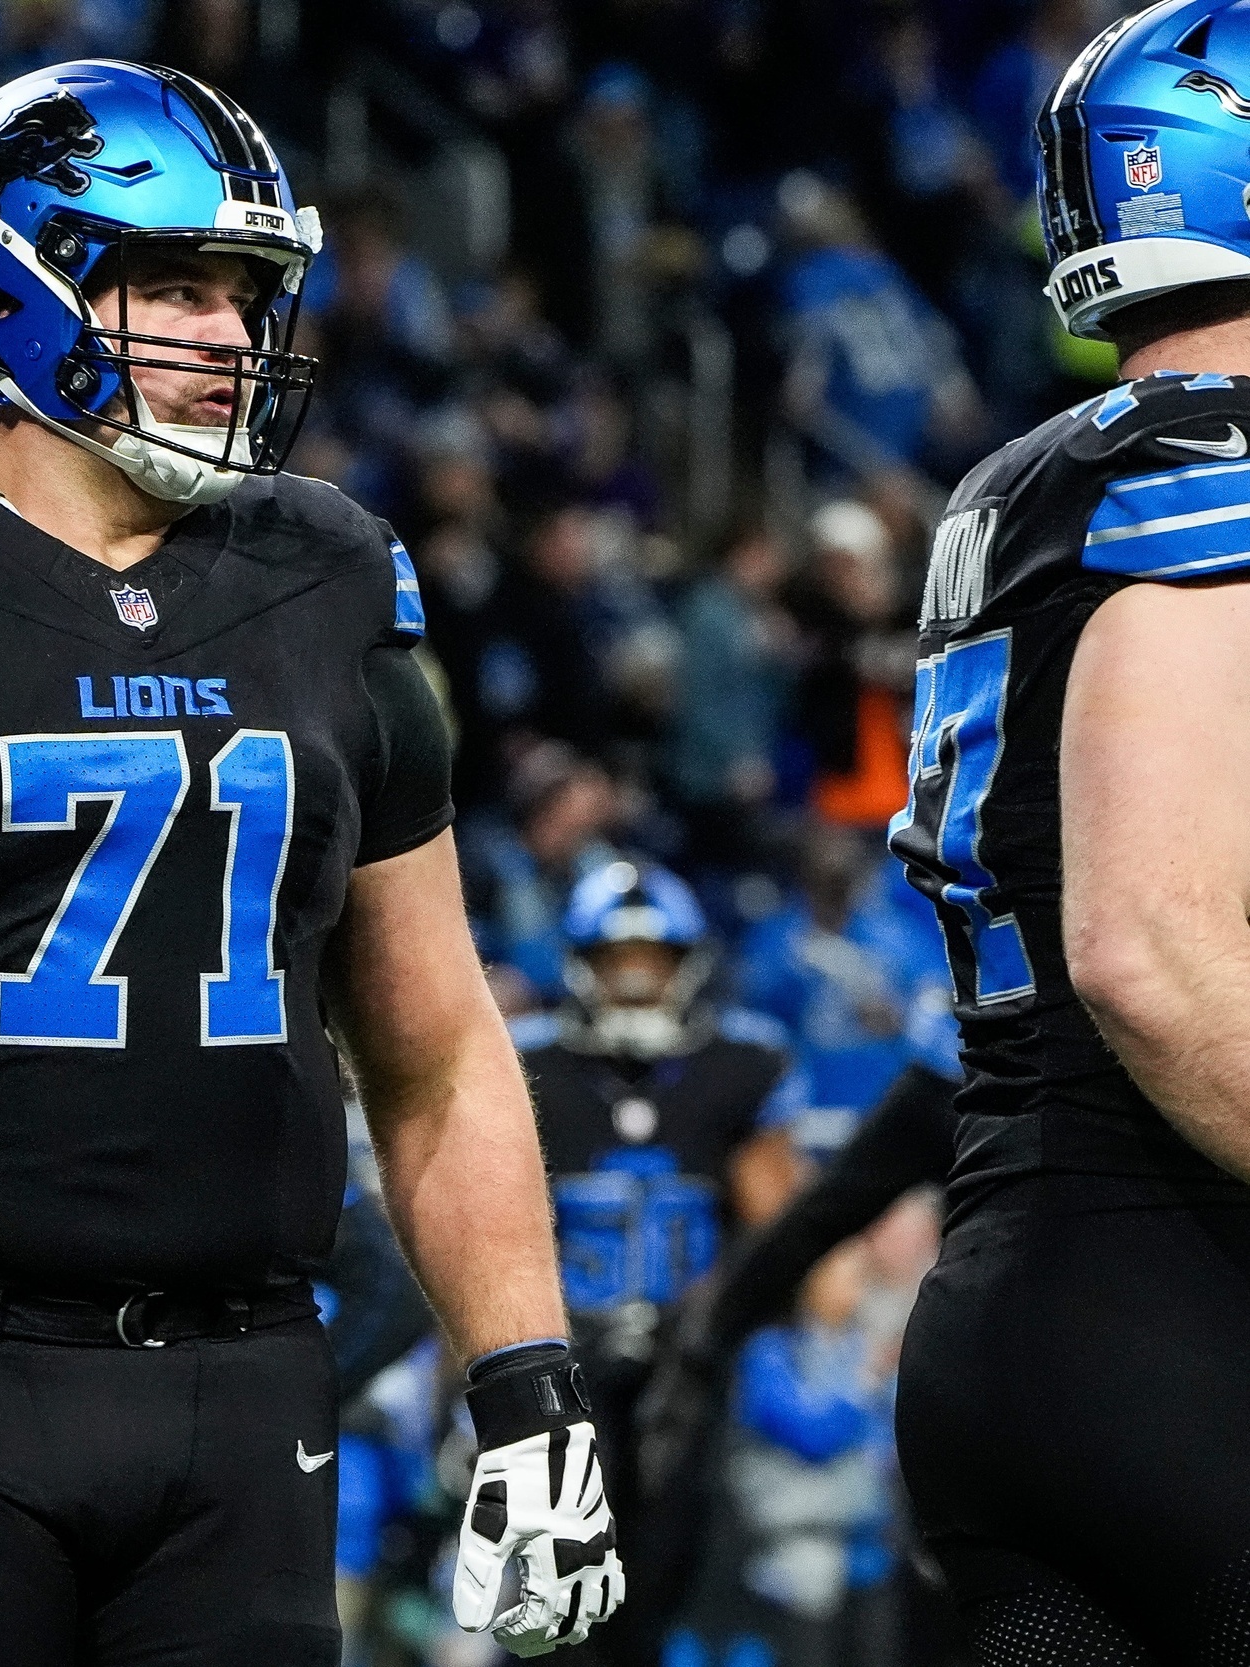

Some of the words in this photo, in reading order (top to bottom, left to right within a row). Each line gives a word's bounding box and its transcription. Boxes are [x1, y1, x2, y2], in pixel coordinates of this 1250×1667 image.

[1131, 164, 1157, 184] NFL
[245, 210, 285, 231] DETROIT
[123, 604, 153, 621] NFL
[75, 675, 233, 718] LIONS
